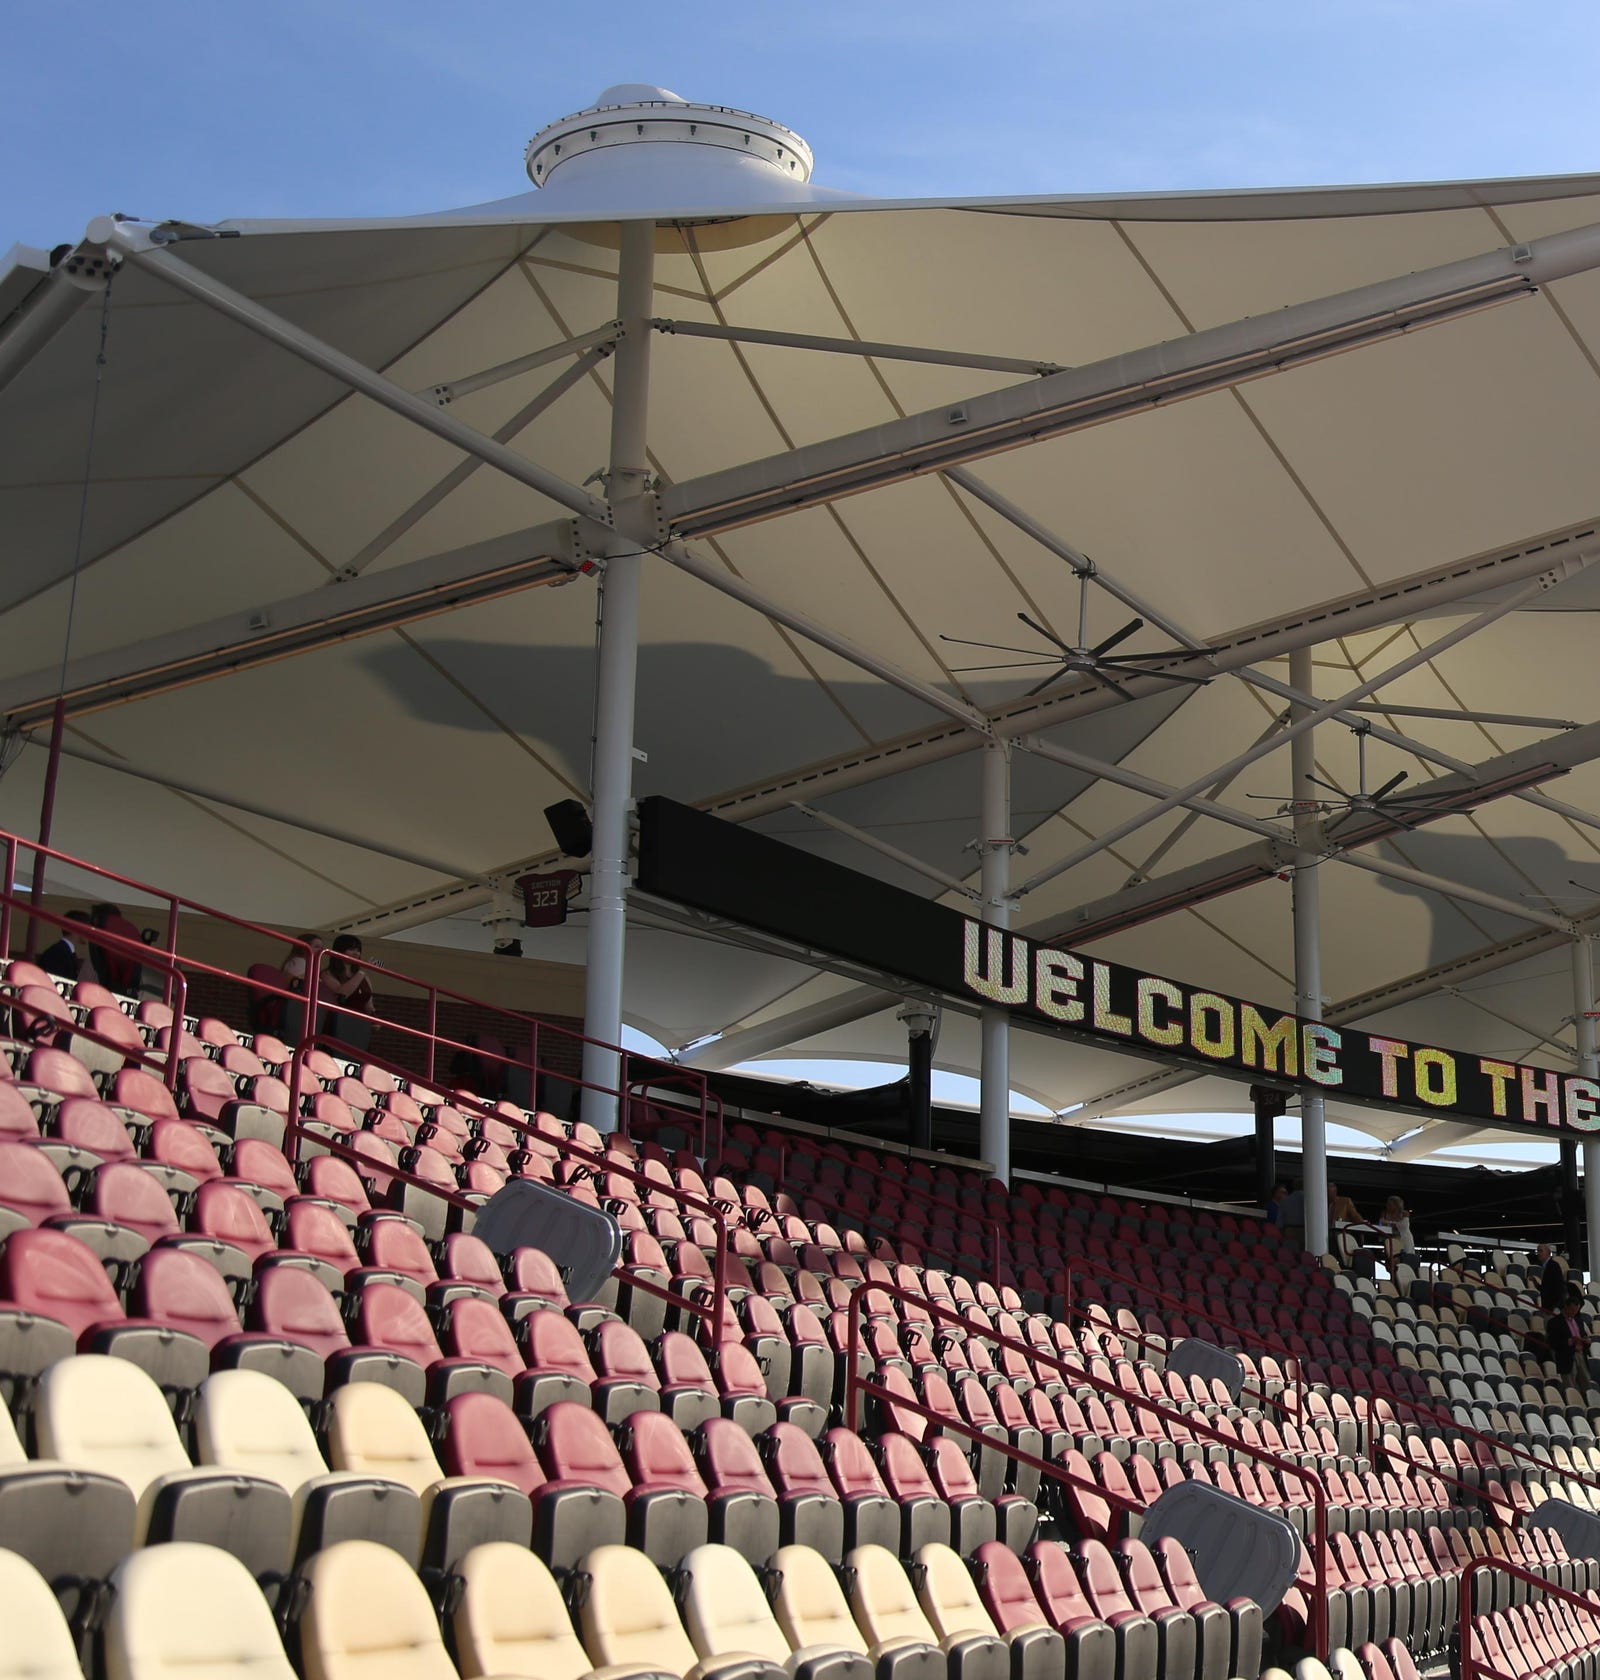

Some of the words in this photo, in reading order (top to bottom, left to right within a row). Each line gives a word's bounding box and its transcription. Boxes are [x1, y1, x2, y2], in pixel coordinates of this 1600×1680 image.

[532, 890, 559, 908] 323
[963, 919, 1342, 1085] WELCOME
[1369, 1037, 1457, 1106] TO
